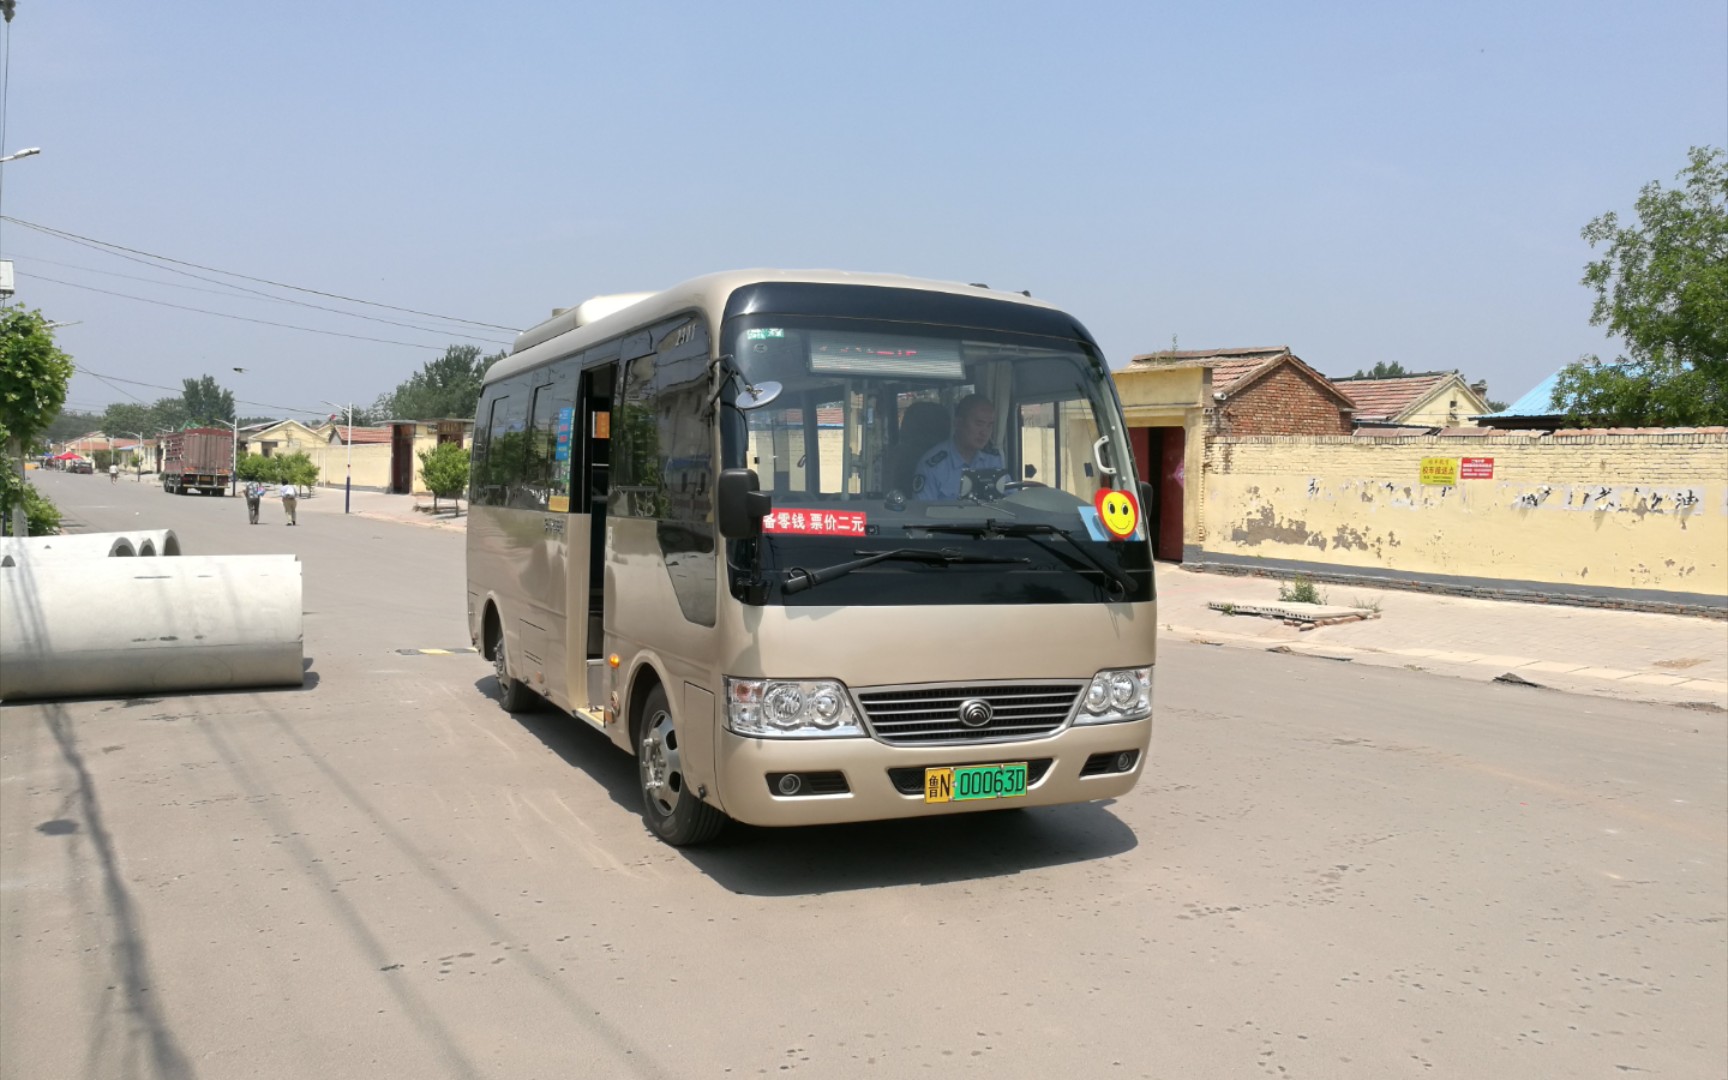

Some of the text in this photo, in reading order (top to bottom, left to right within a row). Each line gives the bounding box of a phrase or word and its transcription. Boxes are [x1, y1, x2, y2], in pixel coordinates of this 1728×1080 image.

[810, 513, 864, 532] 票价二元
[929, 774, 950, 798] 鲁N
